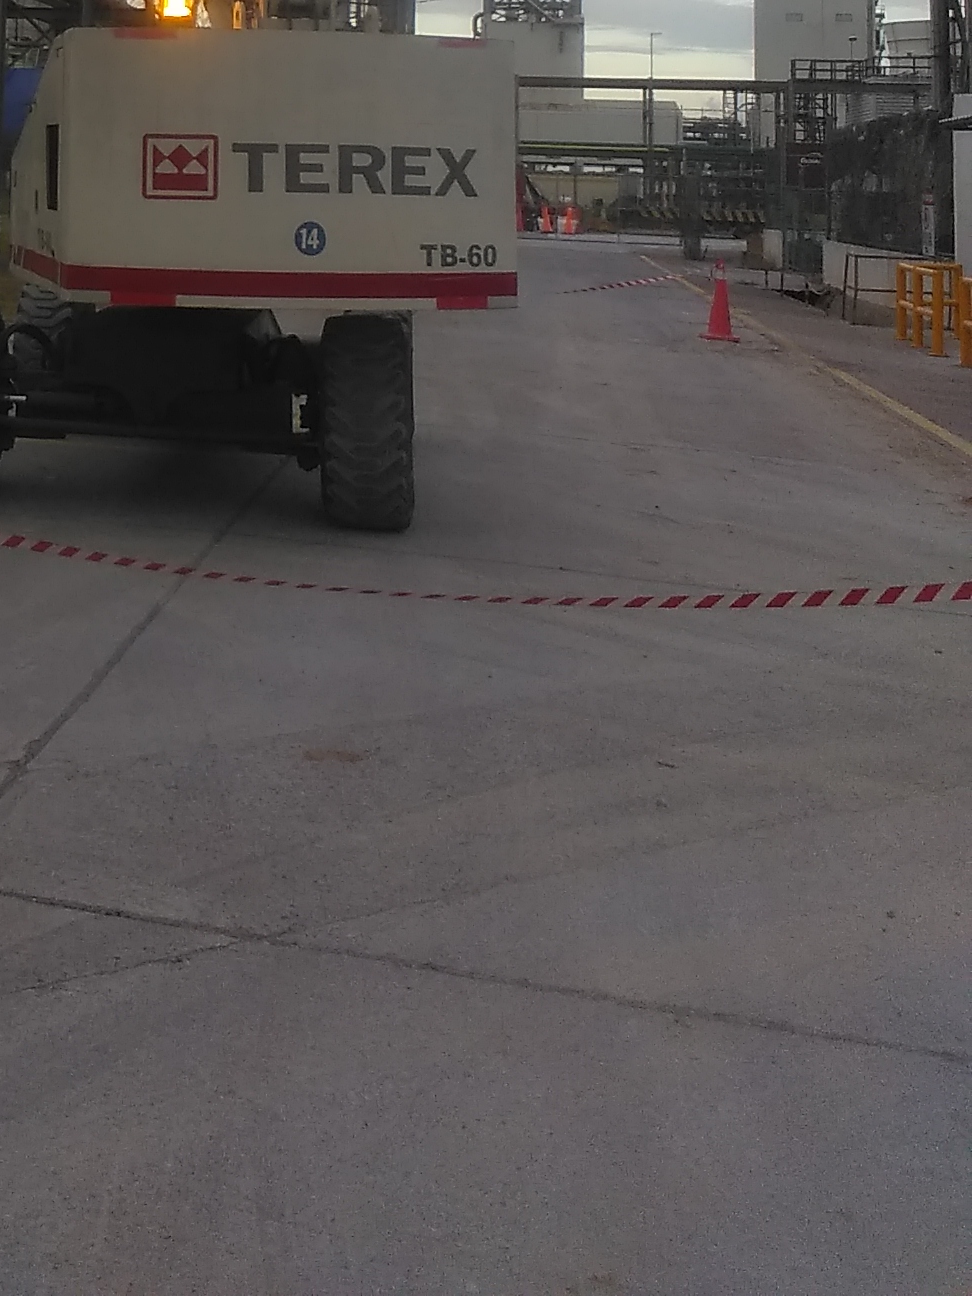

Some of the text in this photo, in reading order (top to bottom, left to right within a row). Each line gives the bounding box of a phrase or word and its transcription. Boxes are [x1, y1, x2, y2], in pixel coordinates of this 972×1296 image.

[231, 142, 479, 198] TEREX
[299, 228, 320, 249] 14
[419, 244, 498, 268] TB-60
